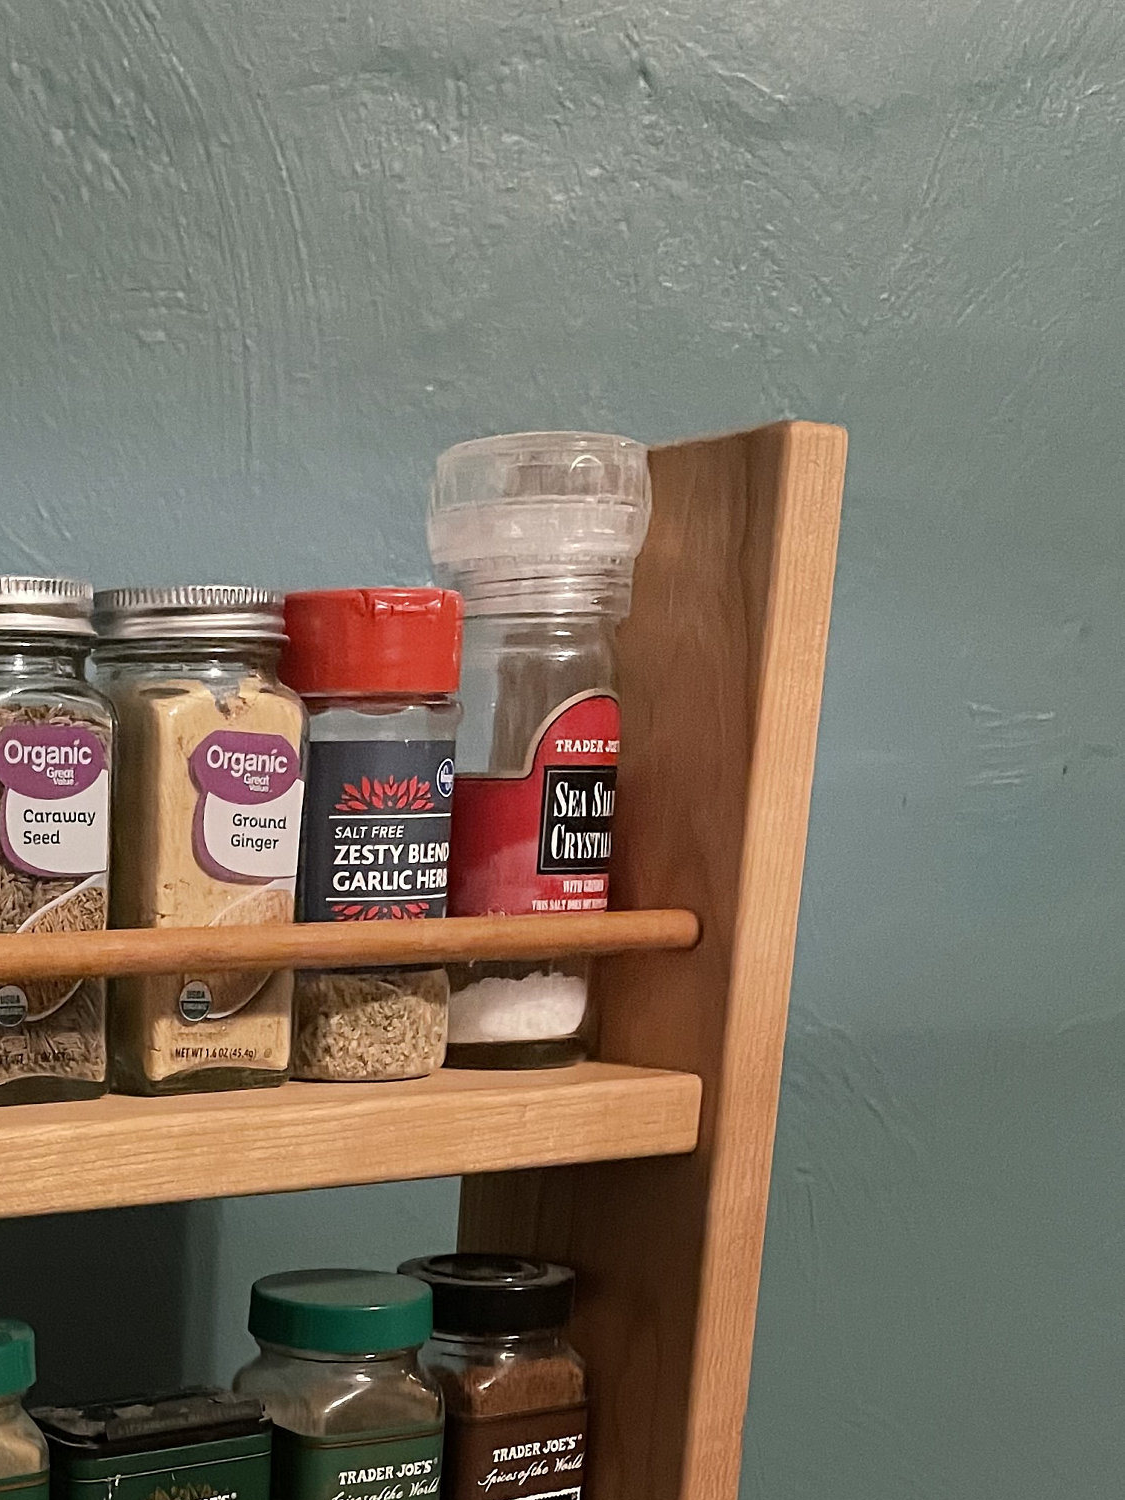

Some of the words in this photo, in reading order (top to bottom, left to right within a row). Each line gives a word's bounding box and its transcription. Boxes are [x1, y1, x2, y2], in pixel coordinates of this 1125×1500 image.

[4, 739, 93, 772] Organic
[555, 739, 604, 753] TRADER
[206, 745, 288, 777] Organic
[46, 766, 75, 779] Great
[243, 773, 270, 785] Great
[553, 781, 587, 817] SEA
[23, 808, 96, 832] Caraway
[232, 813, 287, 830] Ground
[23, 830, 61, 845] Seed
[230, 833, 280, 852] Ginger
[334, 826, 368, 839] SALT
[371, 825, 405, 838] FREE
[333, 844, 405, 865] ZESTY
[408, 842, 450, 864] BLEND
[332, 870, 413, 892] GARLIC
[175, 1048, 189, 1059] NET
[191, 1048, 203, 1058] WT
[206, 1048, 217, 1058] 1.6
[219, 1048, 228, 1058] OZ
[493, 1443, 541, 1462] TRADER
[543, 1436, 577, 1453] JOE'S
[338, 1466, 394, 1486] TRADER
[396, 1460, 433, 1478] JOE'S
[478, 1469, 517, 1492] Spices
[518, 1462, 535, 1486] of
[532, 1460, 549, 1476] the
[553, 1451, 586, 1473] World
[384, 1484, 404, 1500] the
[408, 1476, 441, 1498] World
